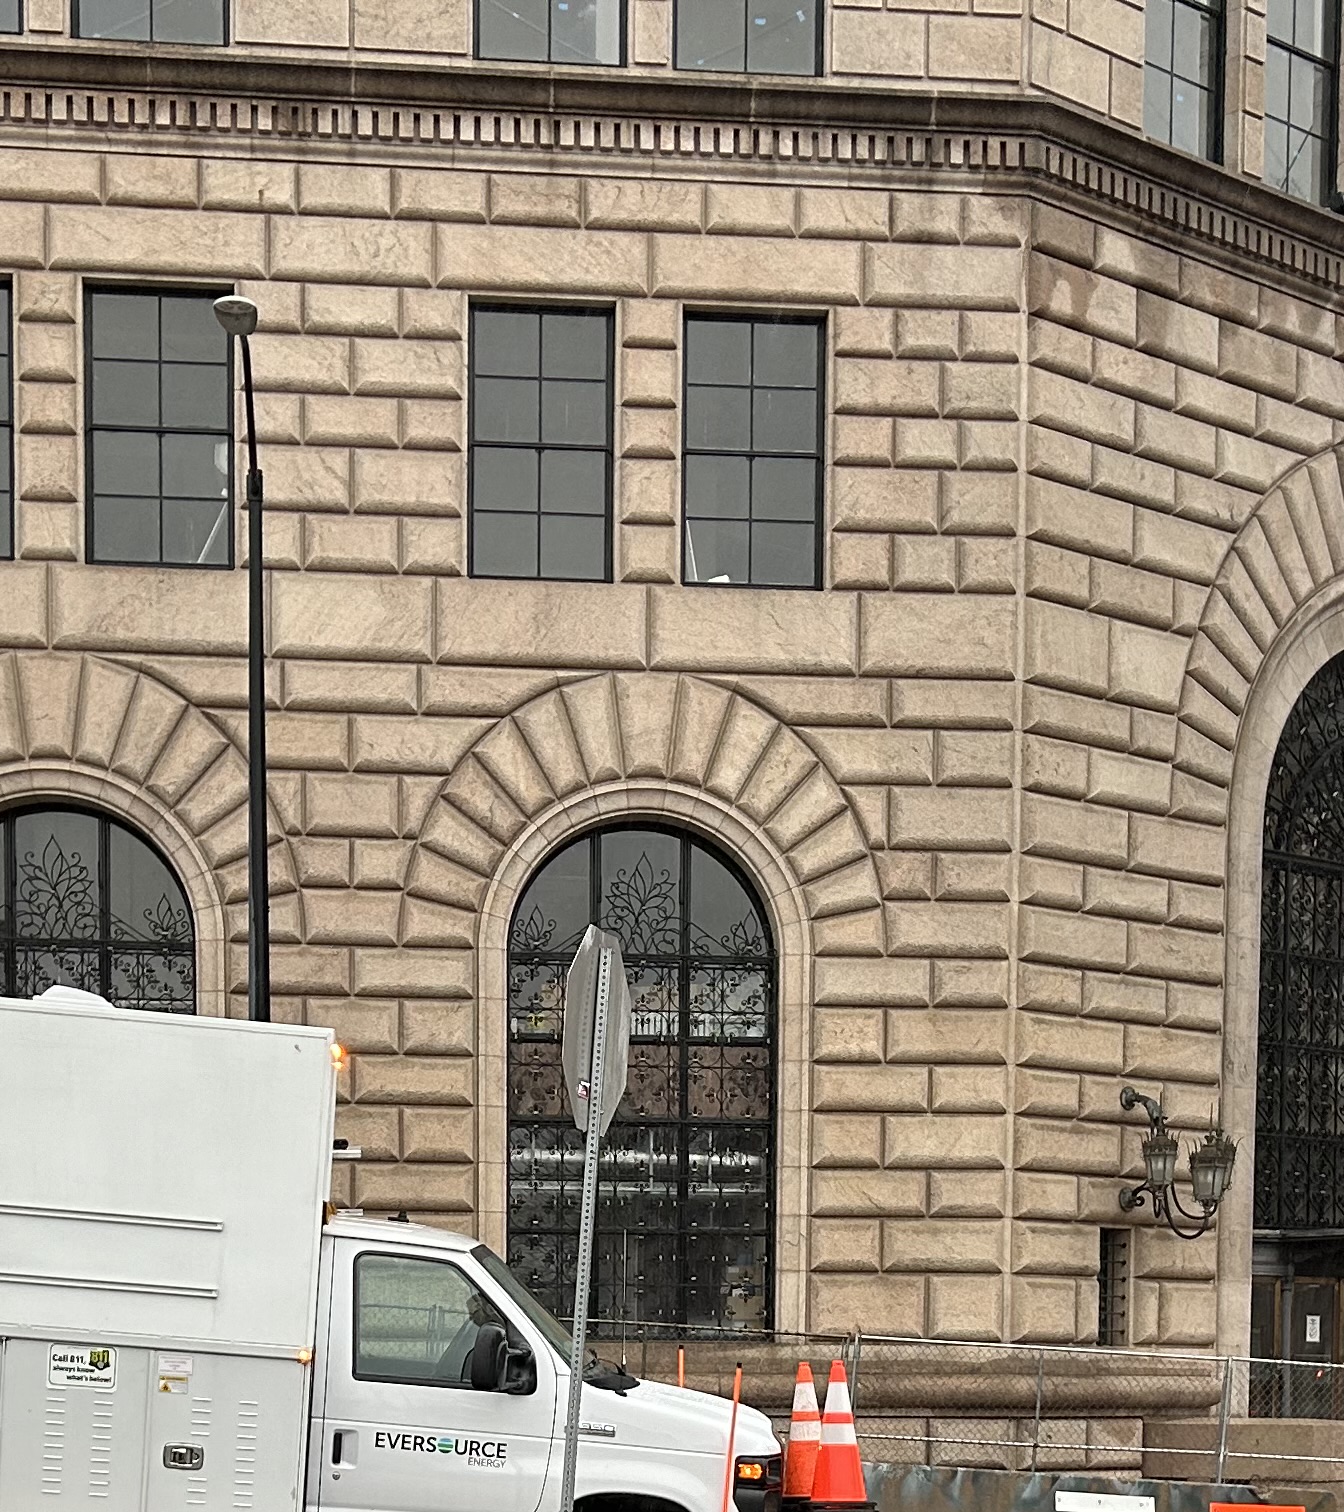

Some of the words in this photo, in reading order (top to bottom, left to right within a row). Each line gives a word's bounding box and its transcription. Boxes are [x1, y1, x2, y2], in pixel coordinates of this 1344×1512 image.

[52, 1354, 69, 1363] Call
[374, 1432, 507, 1459] EVERSOURCE
[467, 1457, 507, 1468] ENERGY
